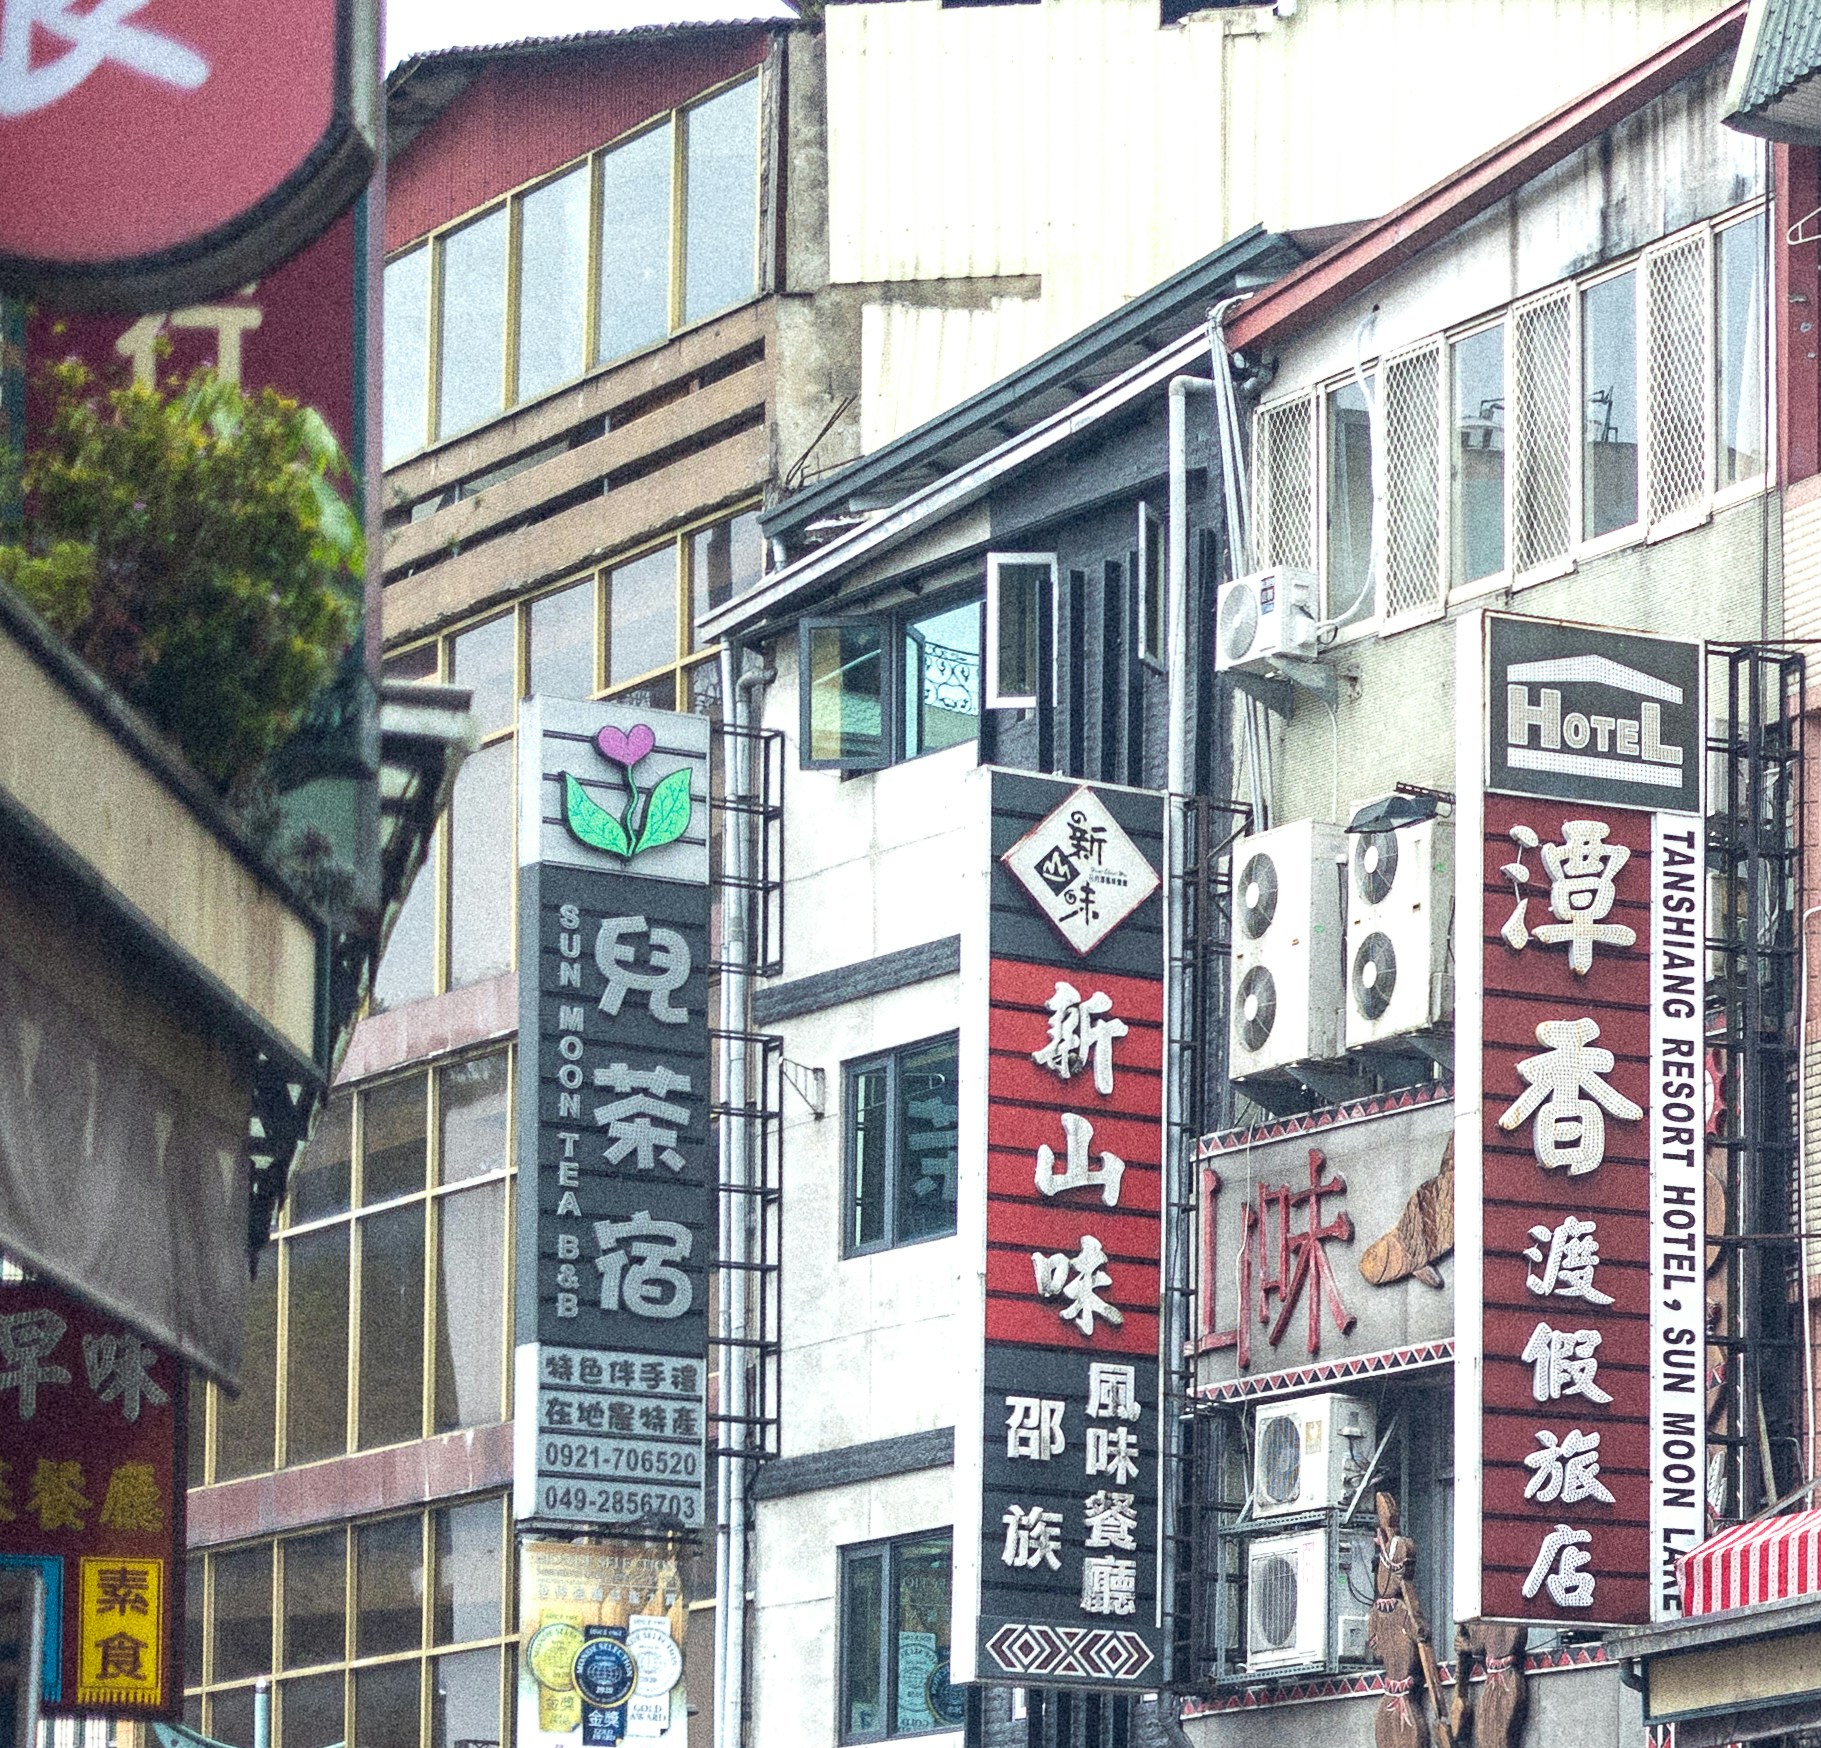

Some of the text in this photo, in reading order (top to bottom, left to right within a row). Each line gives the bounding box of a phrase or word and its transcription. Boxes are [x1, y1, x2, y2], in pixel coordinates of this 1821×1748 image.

[1507, 683, 1684, 765] HOTEL
[1659, 830, 1697, 1018] TANSHIANG
[557, 904, 584, 1318] SUN MOON TEA B&B
[1033, 983, 1129, 1336] 新山味
[1659, 1035, 1697, 1167] RESORT
[1499, 822, 1643, 1607] 潭香渡假旅店
[1659, 1184, 1697, 1310] HOTEL,
[545, 1354, 698, 1392] 特色伴手禮
[1659, 1323, 1697, 1395] SUN
[545, 1442, 697, 1476] 0921-706520
[545, 1485, 696, 1520] 049-2856703
[1000, 1395, 1067, 1573] 邵族
[1080, 1362, 1139, 1618] 風味餐廳
[1659, 1411, 1697, 1506] MOON
[96, 1569, 150, 1681] 素食
